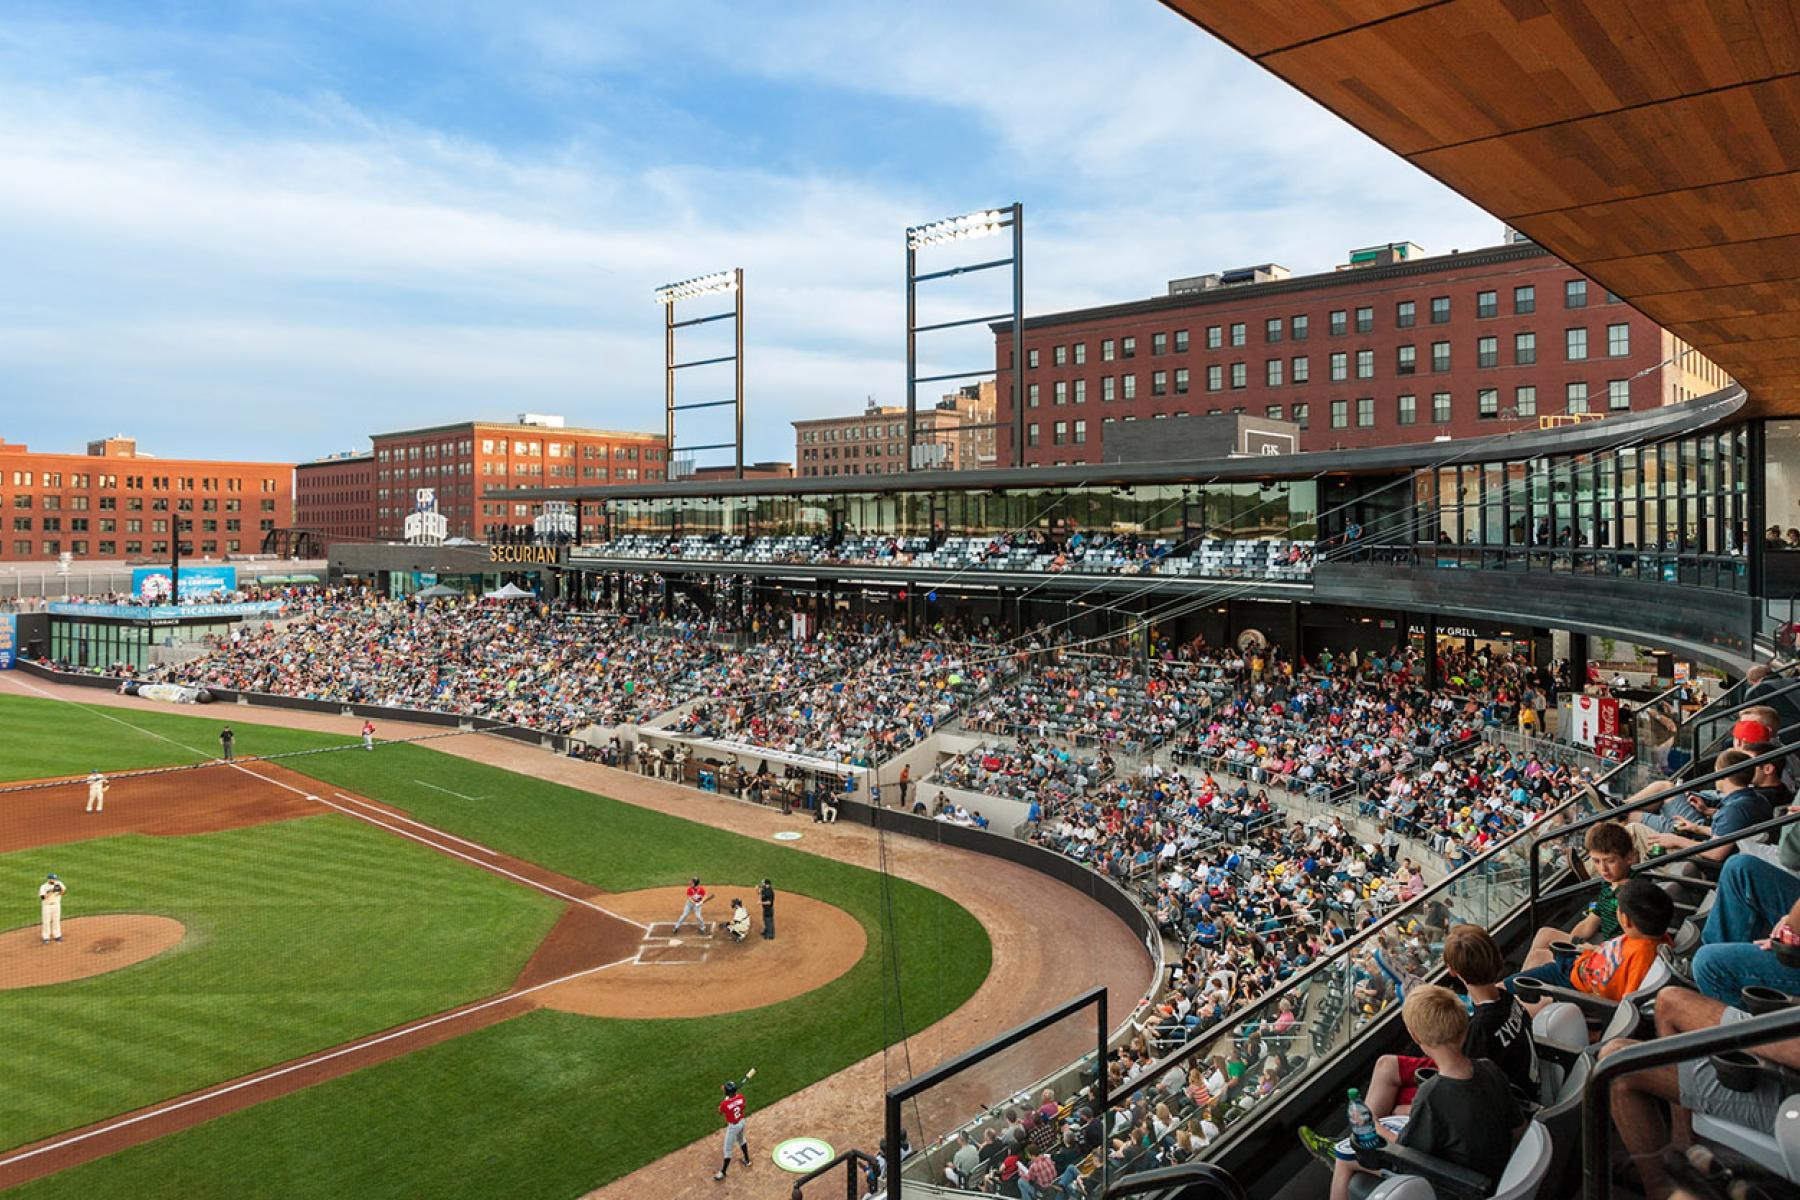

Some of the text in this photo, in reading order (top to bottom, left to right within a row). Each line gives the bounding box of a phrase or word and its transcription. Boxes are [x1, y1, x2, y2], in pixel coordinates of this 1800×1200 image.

[489, 545, 556, 564] SECURIAN
[1447, 627, 1478, 637] GRILL
[733, 1106, 741, 1119] 2
